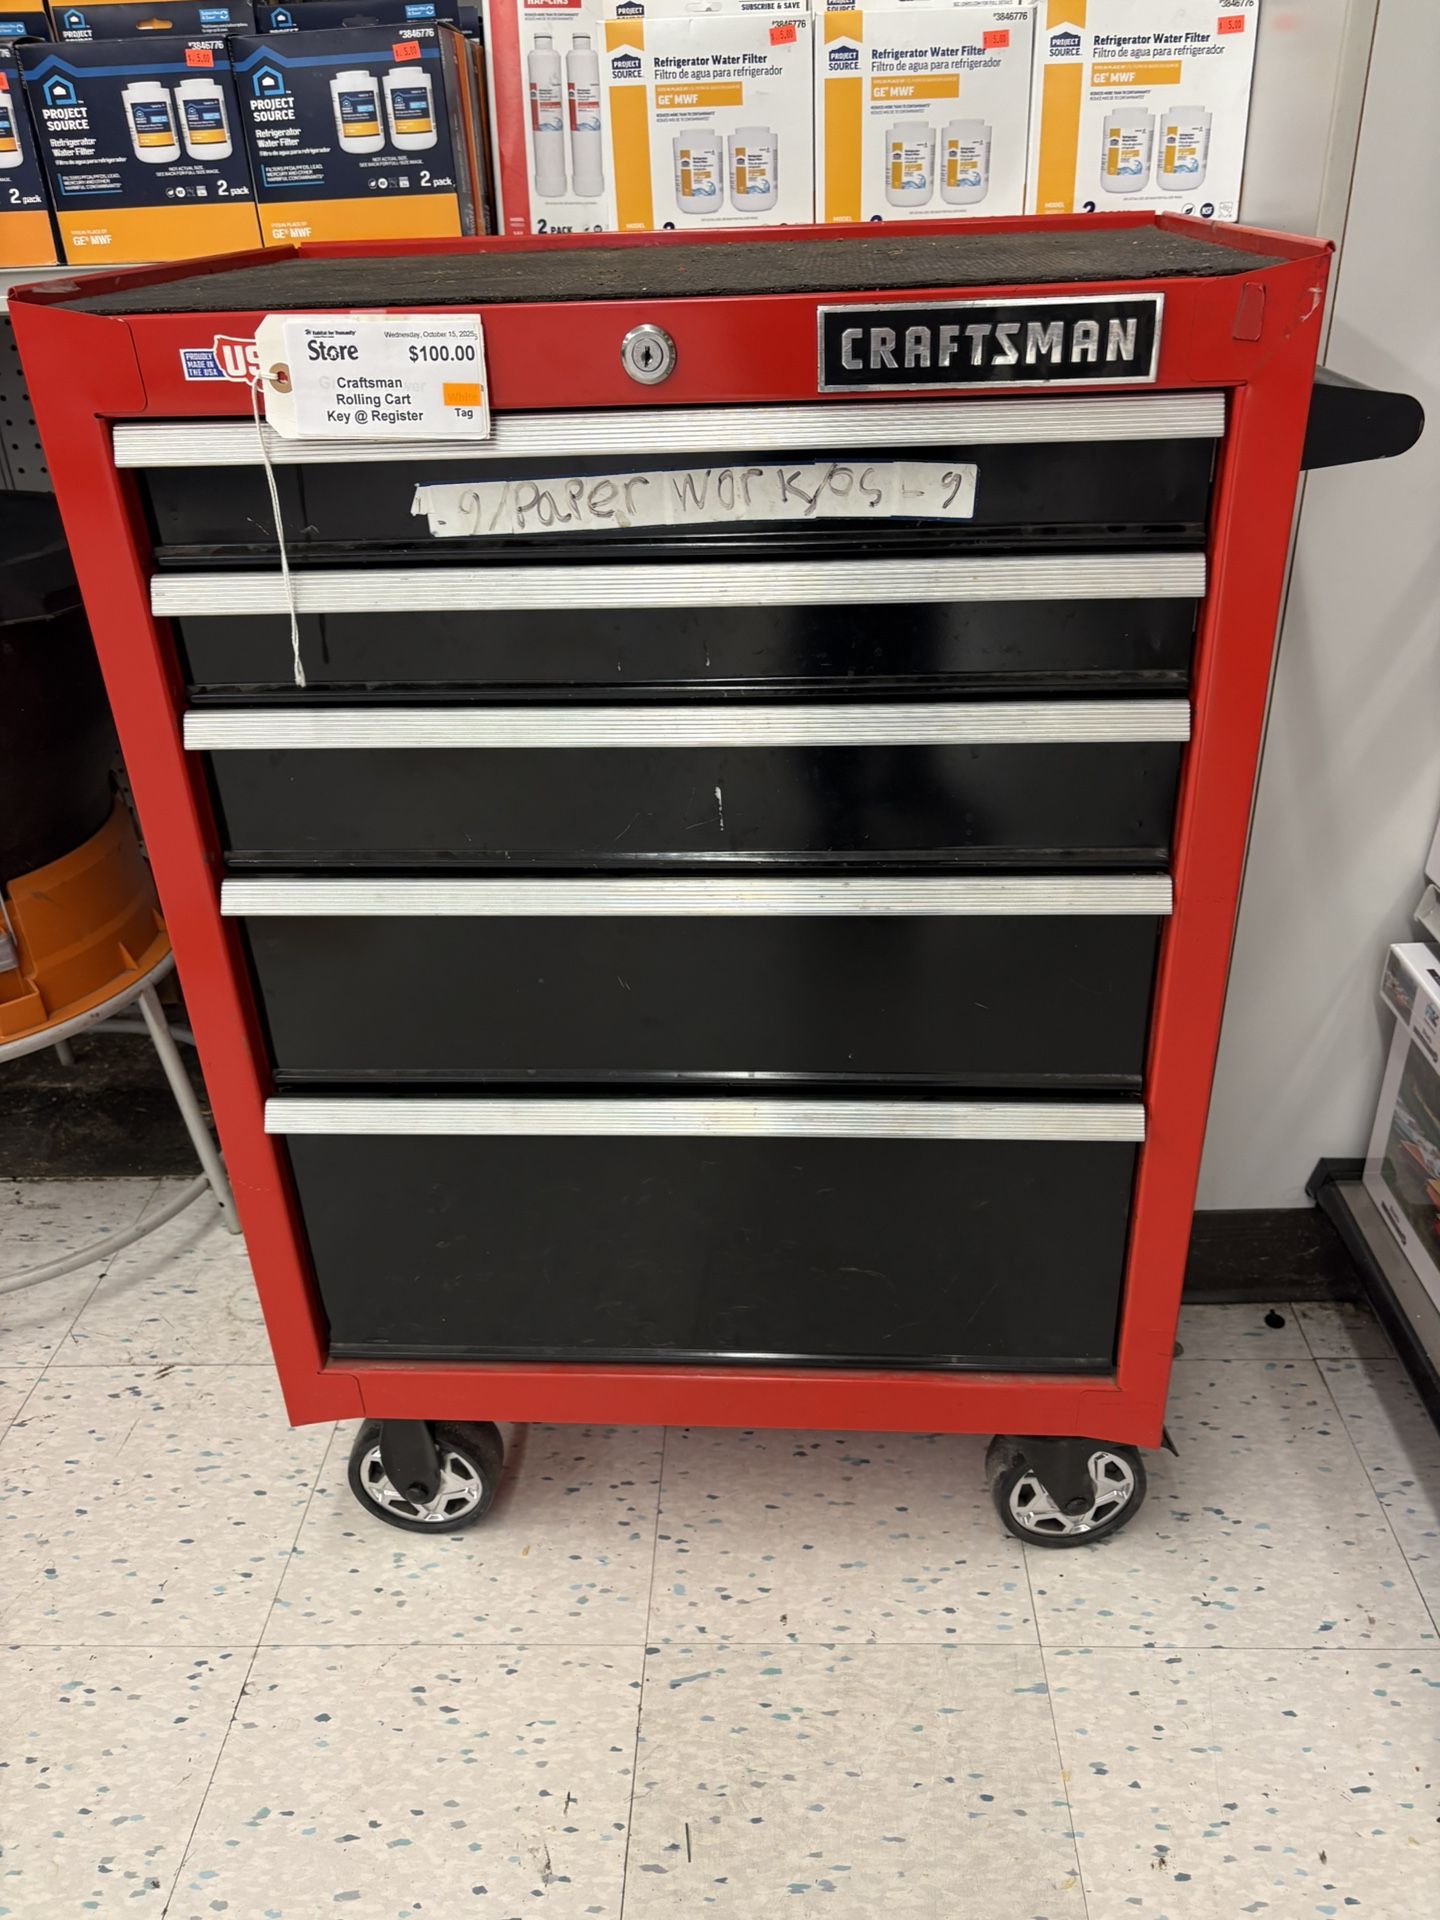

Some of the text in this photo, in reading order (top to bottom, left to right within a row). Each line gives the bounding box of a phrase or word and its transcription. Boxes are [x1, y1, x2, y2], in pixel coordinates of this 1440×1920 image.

[62, 30, 92, 38] PROJECT
[1094, 32, 1210, 47] Refrigerator Water Filter
[1052, 38, 1079, 46] PROJECT
[872, 46, 986, 60] Refrigerator Water Filter
[1050, 48, 1080, 57] SOURCE
[1093, 44, 1225, 59] Filtro de agua para refrigerador
[614, 60, 639, 68] PROJECT
[654, 53, 767, 68] Refrigerator Water Filter
[871, 57, 1002, 72] Filtro de agua para refrigerador
[828, 62, 859, 71] SOURCE
[612, 70, 642, 78] SOURCE
[654, 65, 782, 80] Filtro de agua para refrigerador
[1110, 72, 1136, 82] MWF
[890, 86, 914, 96] MWF
[250, 97, 294, 110] PROJECT
[674, 94, 698, 104] MWF
[42, 107, 88, 120] PROJECT
[253, 109, 295, 122] SOURCE
[46, 120, 90, 131] SOURCE
[255, 128, 301, 138] Refrigerator
[50, 138, 96, 148] Refrigerator
[256, 138, 300, 148] Water Filter
[52, 147, 96, 156] Water Filter
[420, 170, 452, 187] 2 pack
[217, 180, 249, 196] 2 pack
[8, 188, 42, 204] 2 pack
[290, 227, 312, 237] MWF
[538, 219, 572, 234] 2 PACK
[90, 234, 112, 245] MWF
[384, 331, 422, 339] Wednesday,
[841, 318, 1138, 370] CRAFTSMAN
[307, 340, 359, 361] Store
[409, 345, 475, 363] $100.00
[189, 368, 218, 376] THE USA
[337, 377, 403, 389] Craftsman
[336, 394, 411, 407] Rolling Cart
[327, 410, 424, 424] Key @ Register
[454, 408, 473, 419] Tag
